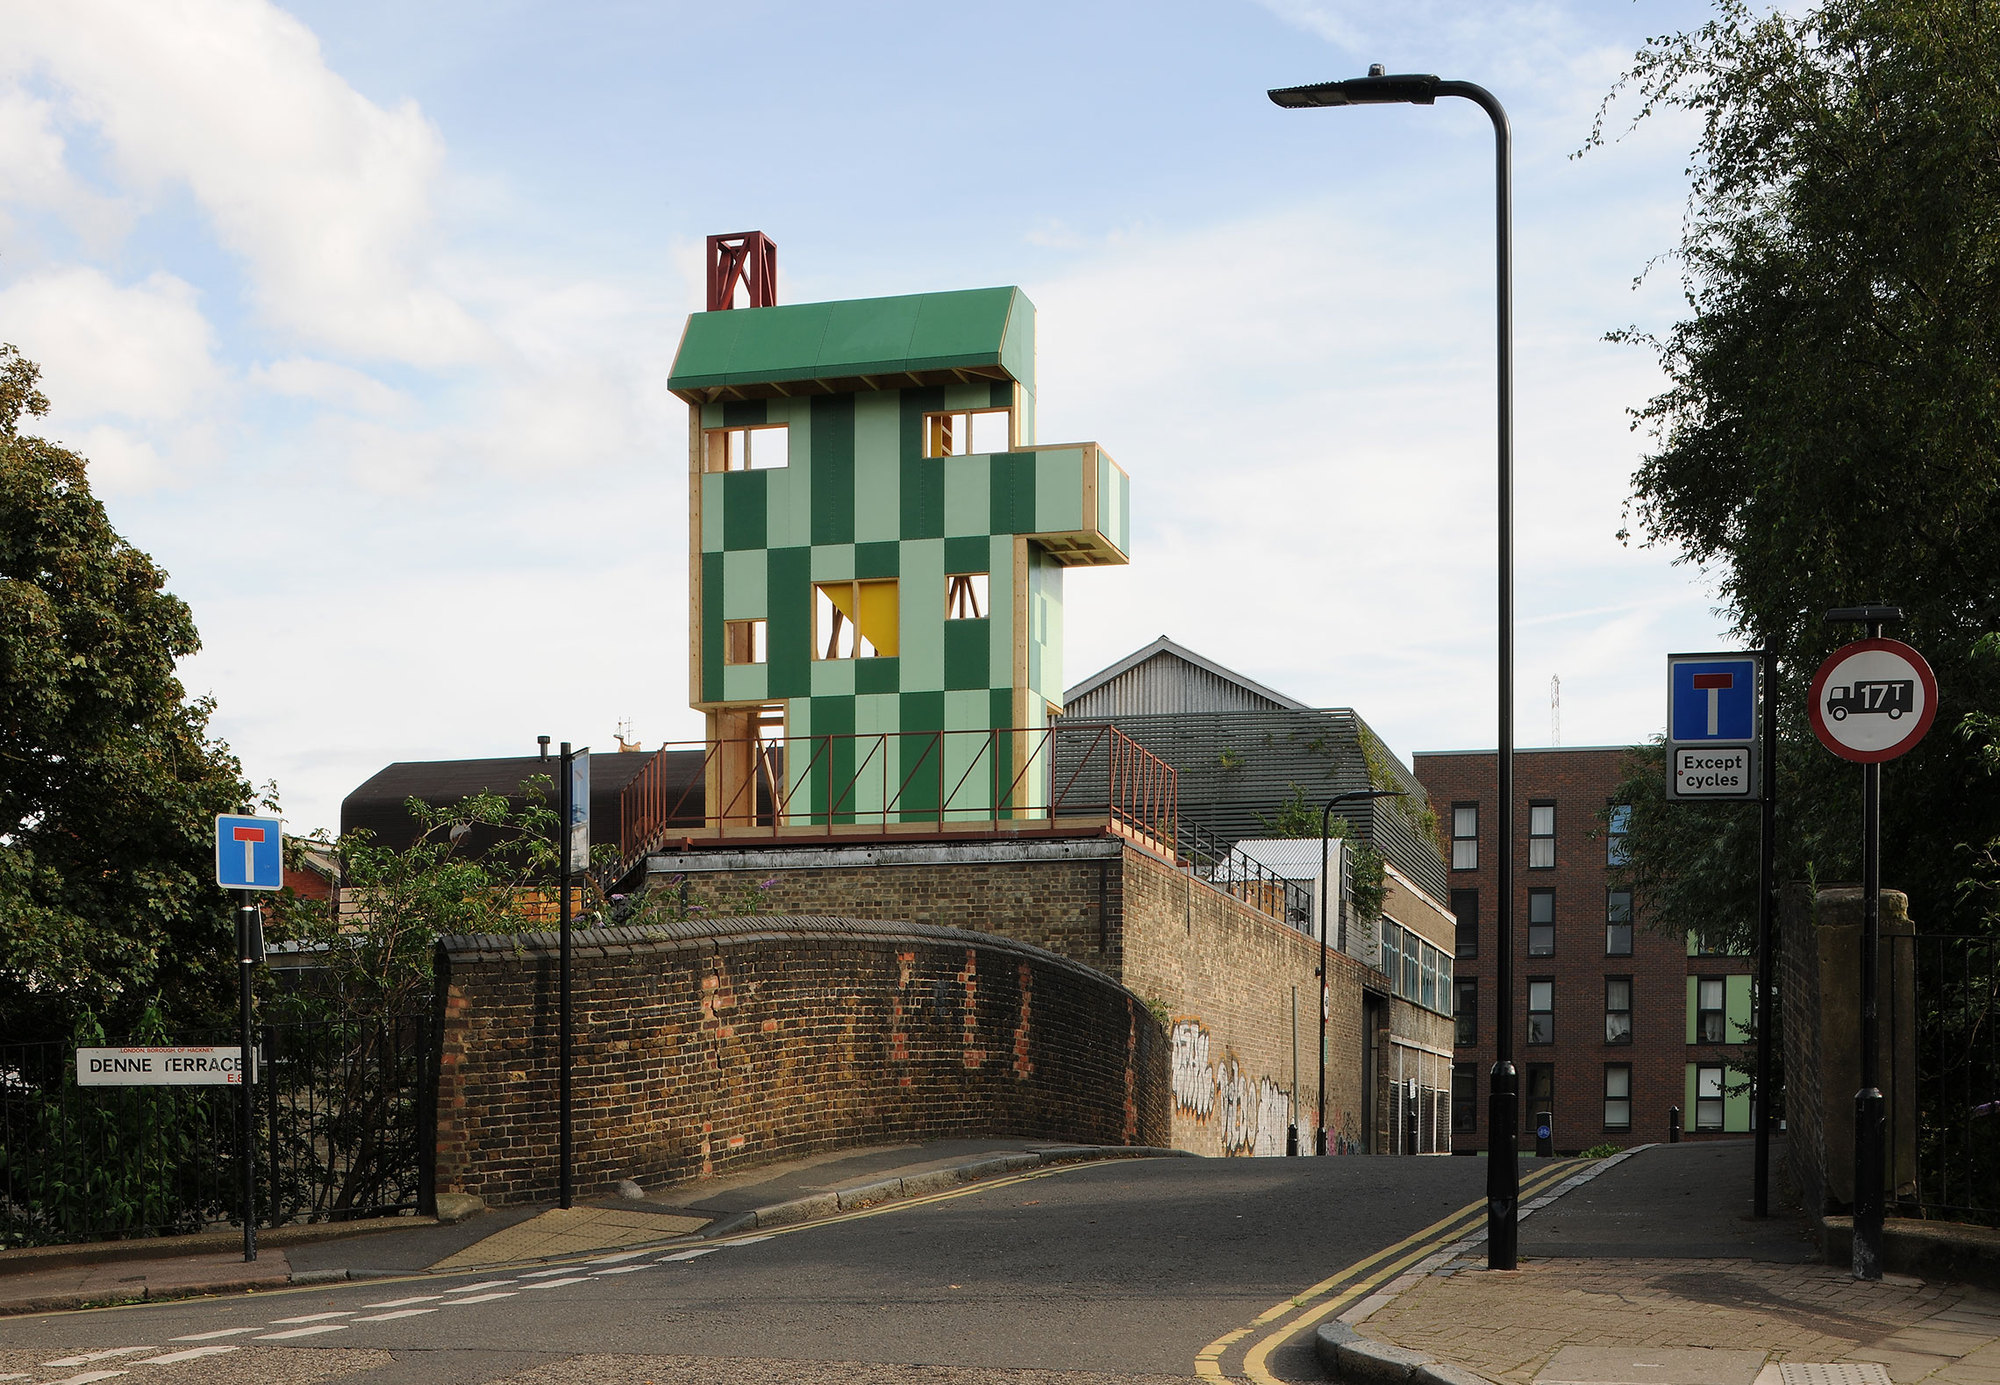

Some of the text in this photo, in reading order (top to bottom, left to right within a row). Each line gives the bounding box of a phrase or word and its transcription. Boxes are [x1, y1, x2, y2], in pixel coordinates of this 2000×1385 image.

[1684, 756, 1742, 771] Except
[1686, 773, 1739, 788] cycles
[90, 1058, 152, 1072] DENNE
